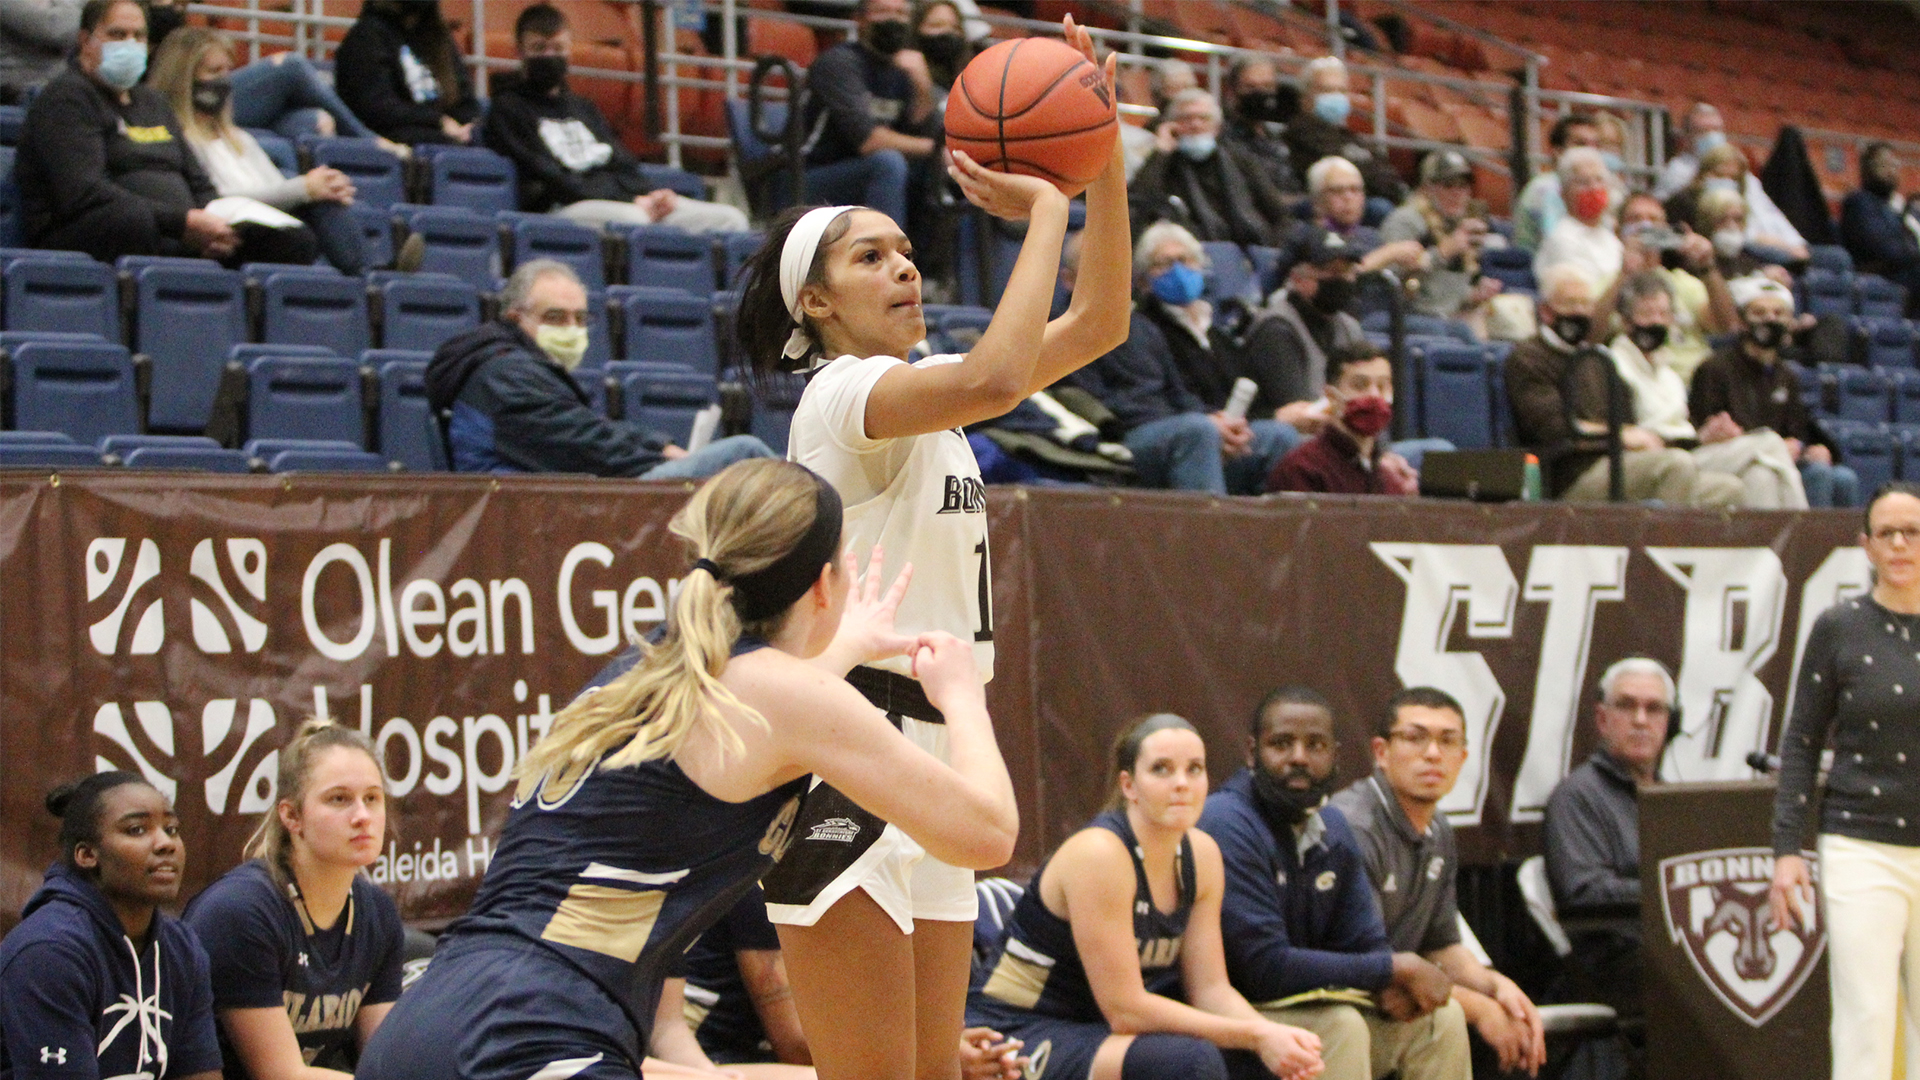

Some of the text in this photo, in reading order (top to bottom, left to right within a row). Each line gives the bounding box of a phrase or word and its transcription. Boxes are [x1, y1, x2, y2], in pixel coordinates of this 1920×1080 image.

[302, 538, 688, 661] Olean Ge
[466, 836, 496, 877] H
